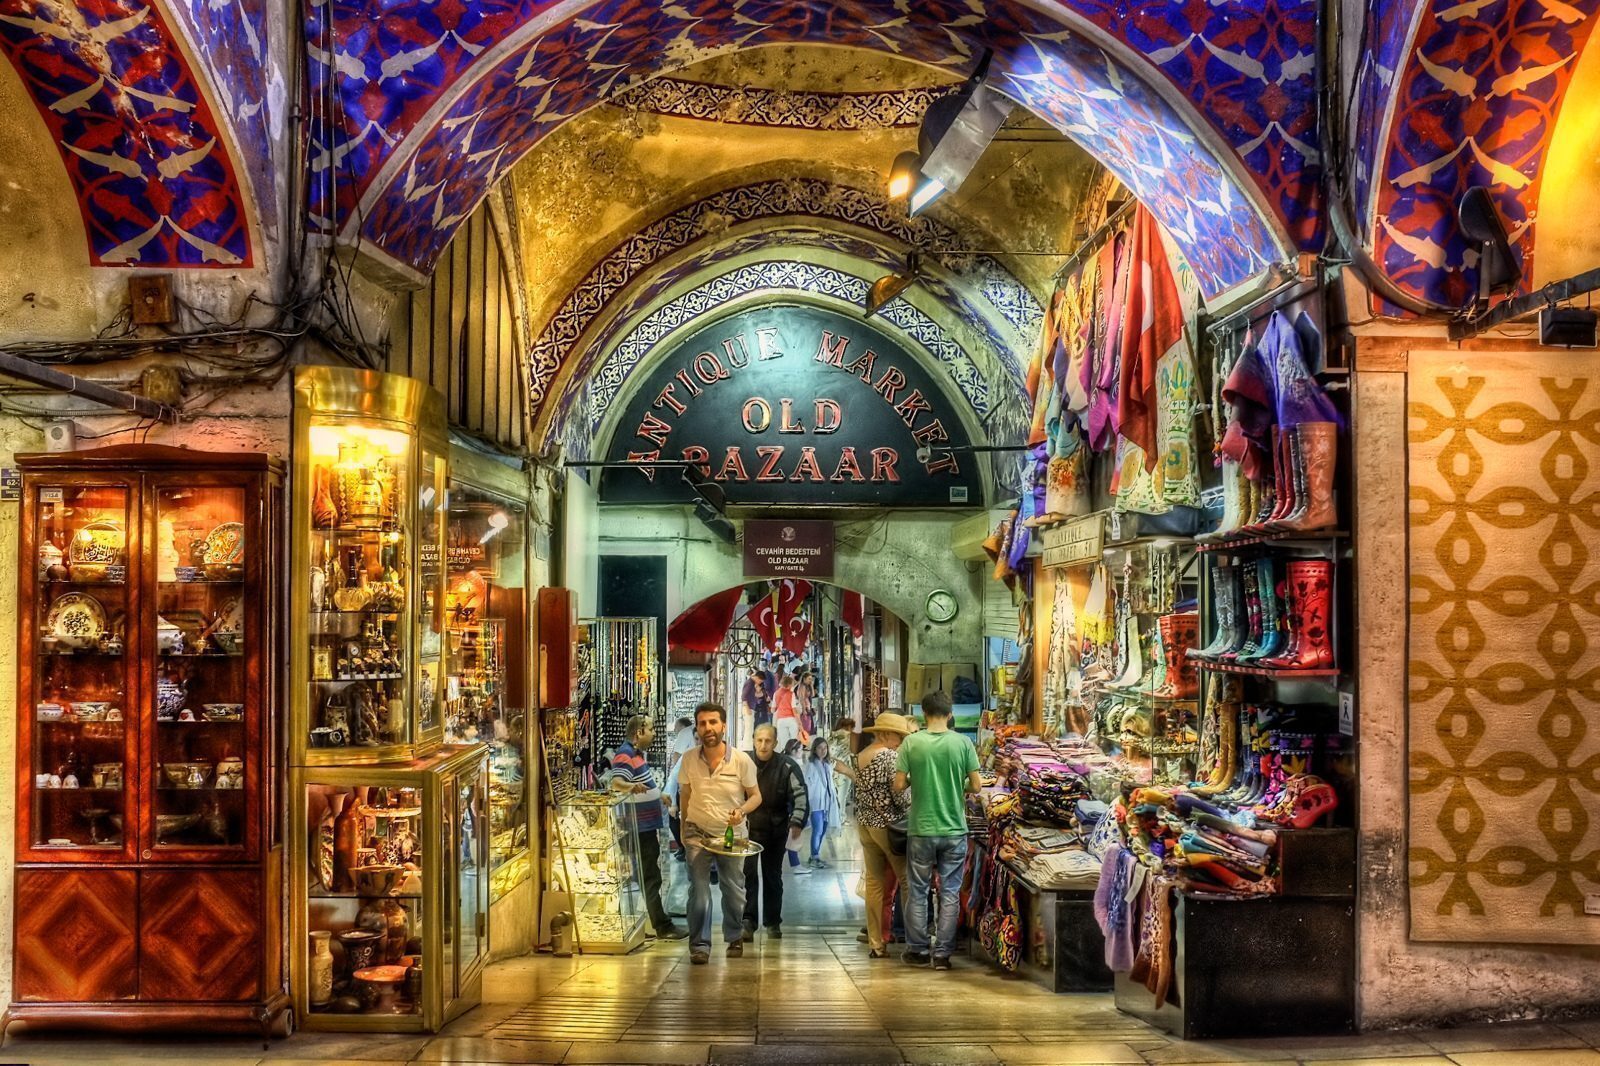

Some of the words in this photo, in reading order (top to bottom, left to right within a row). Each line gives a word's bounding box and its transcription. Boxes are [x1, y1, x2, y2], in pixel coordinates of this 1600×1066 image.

[627, 327, 783, 482] ANTIQUE
[814, 330, 960, 475] MARKET
[742, 396, 842, 434] OLD
[682, 446, 900, 482] BAZAAR
[756, 546, 784, 555] CEVAHİR
[785, 546, 821, 555] BEDESTENİ
